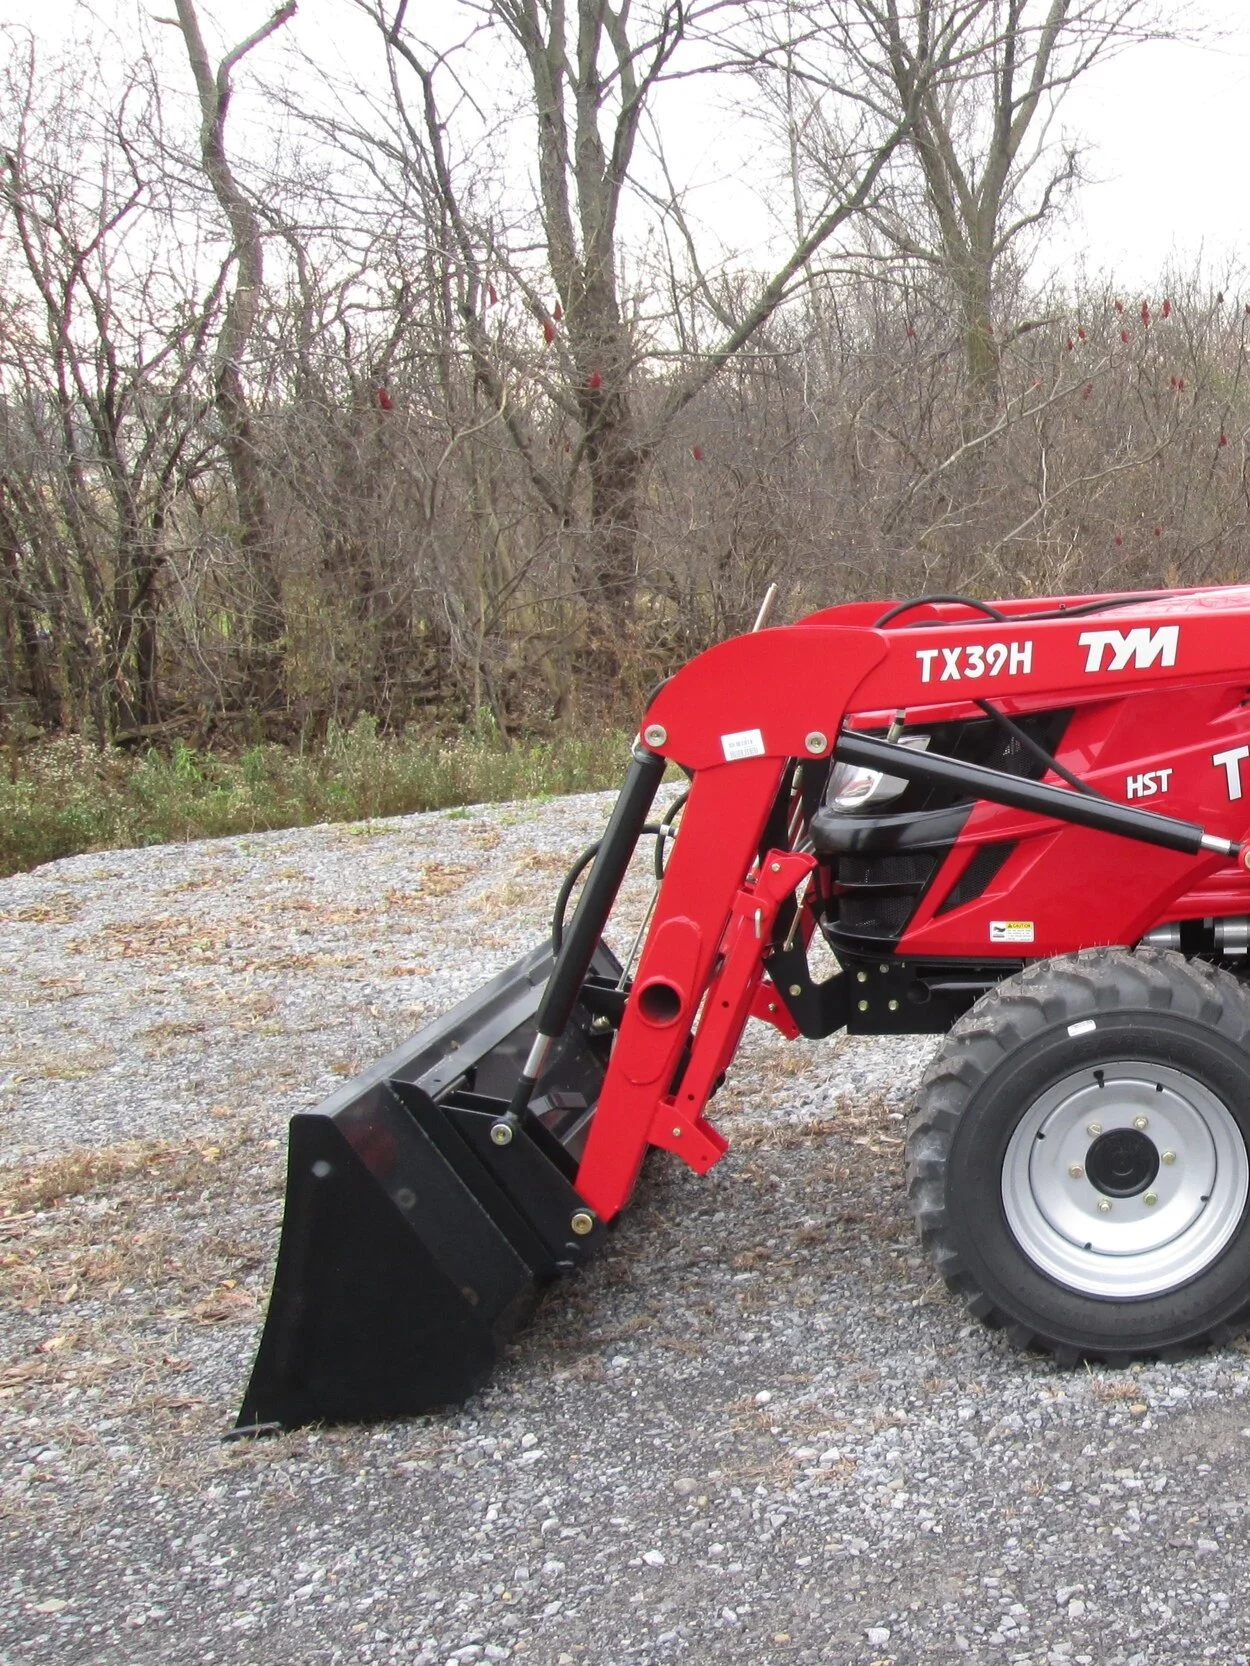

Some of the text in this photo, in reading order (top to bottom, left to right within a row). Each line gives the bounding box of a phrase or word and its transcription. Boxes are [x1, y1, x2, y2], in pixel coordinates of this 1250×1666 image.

[915, 640, 1033, 683] TX39H
[1078, 625, 1180, 673] TYM
[1127, 768, 1173, 799] HST
